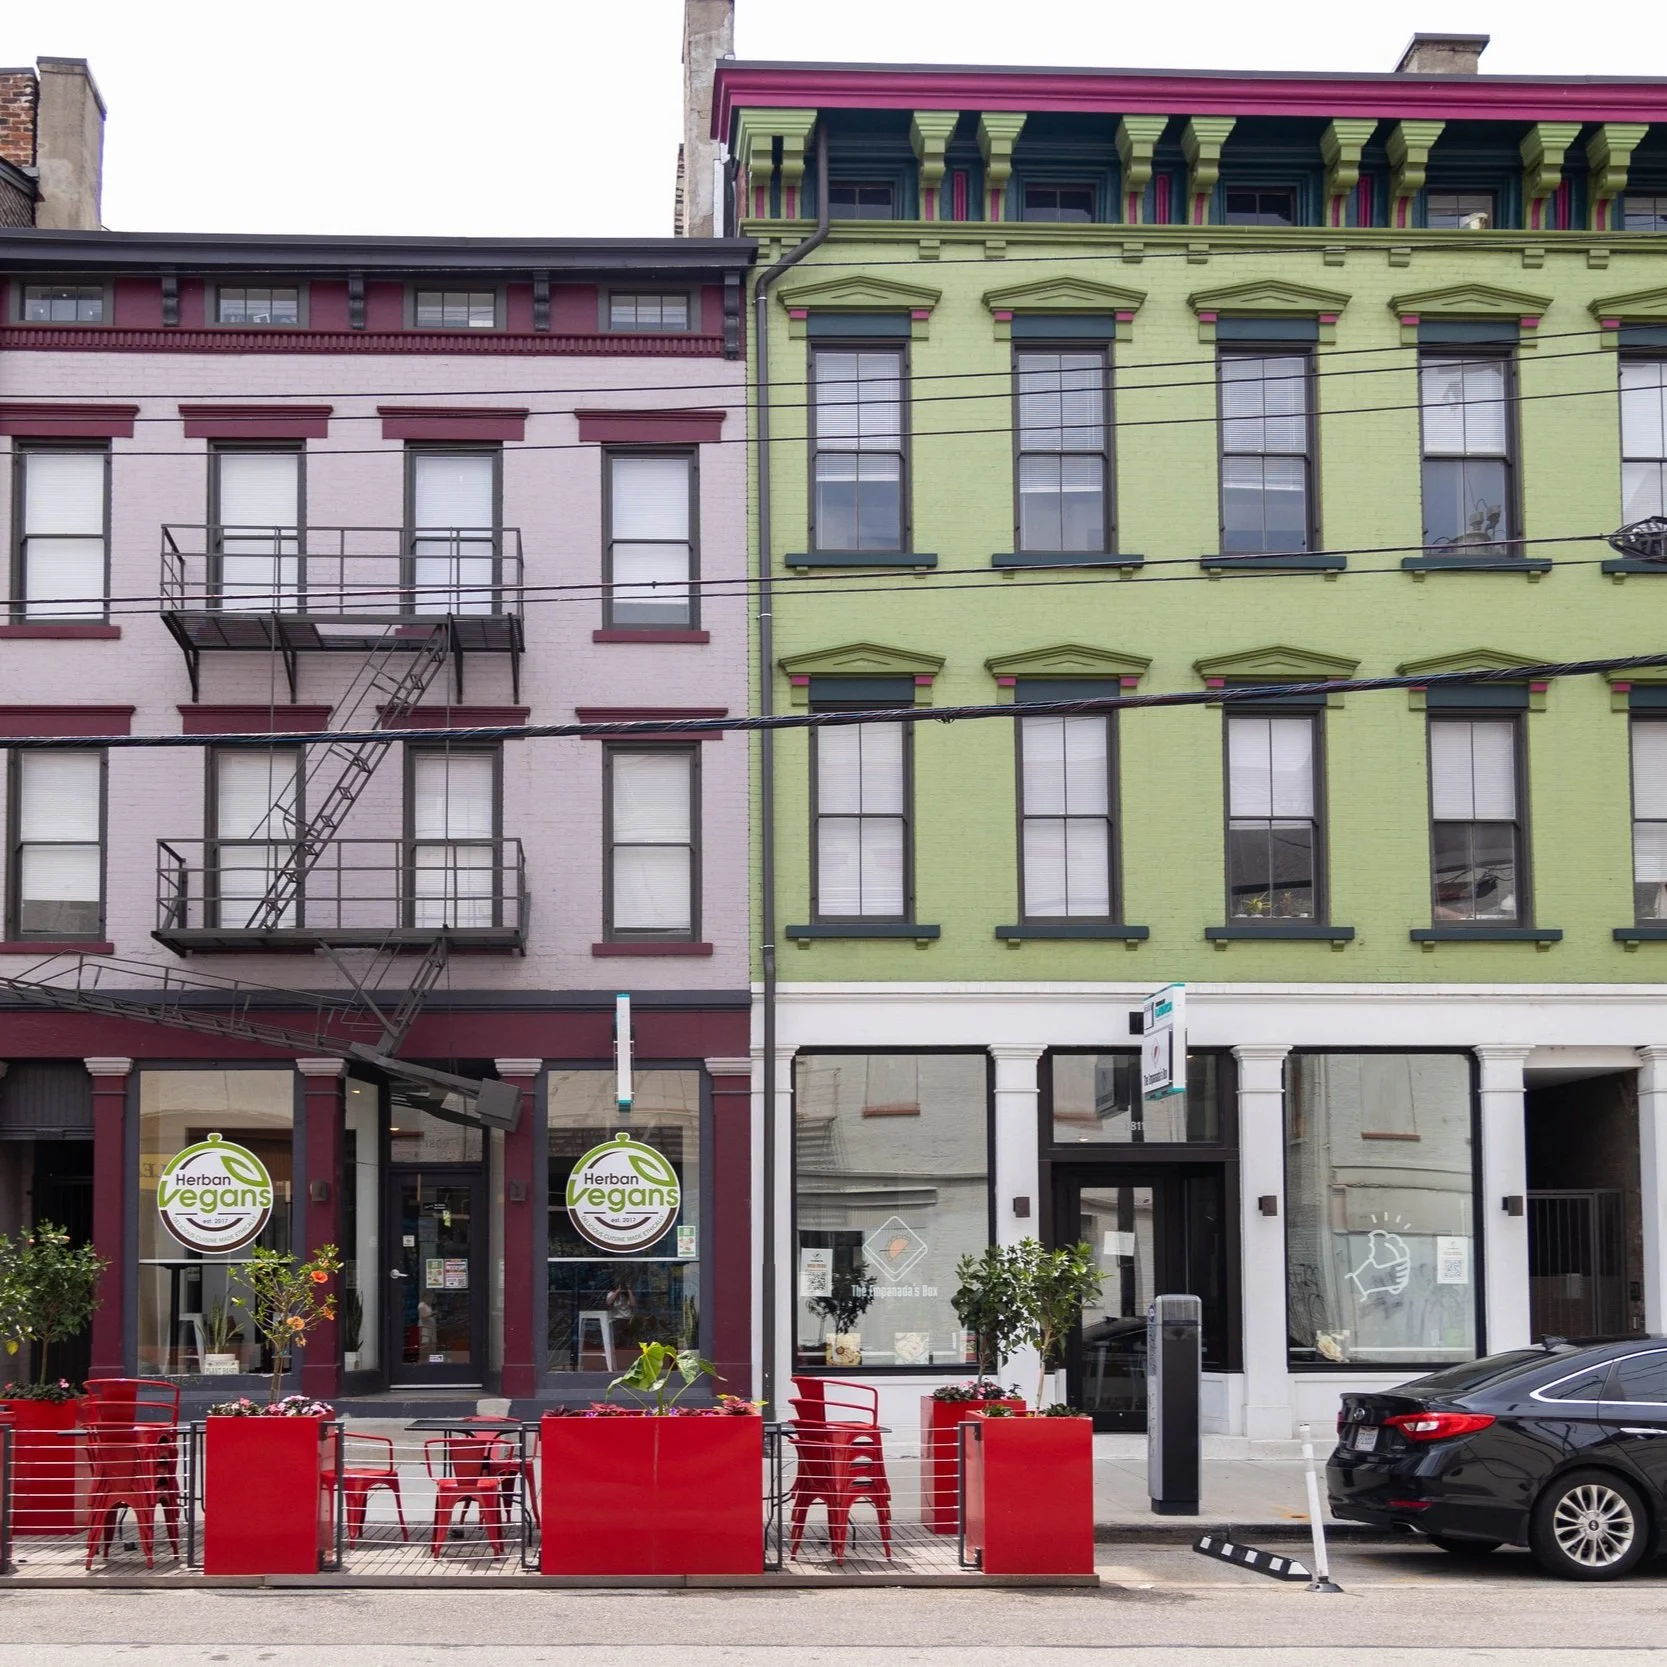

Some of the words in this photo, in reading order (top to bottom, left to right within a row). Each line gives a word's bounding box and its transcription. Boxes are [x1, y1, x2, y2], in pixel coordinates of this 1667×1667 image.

[176, 1174, 231, 1186] Herban
[584, 1173, 639, 1185] Herban
[159, 1180, 272, 1214] Vegans
[567, 1179, 679, 1213] Vegans
[851, 1284, 867, 1298] The
[869, 1283, 920, 1299] Empanada's
[922, 1284, 939, 1297] Box
